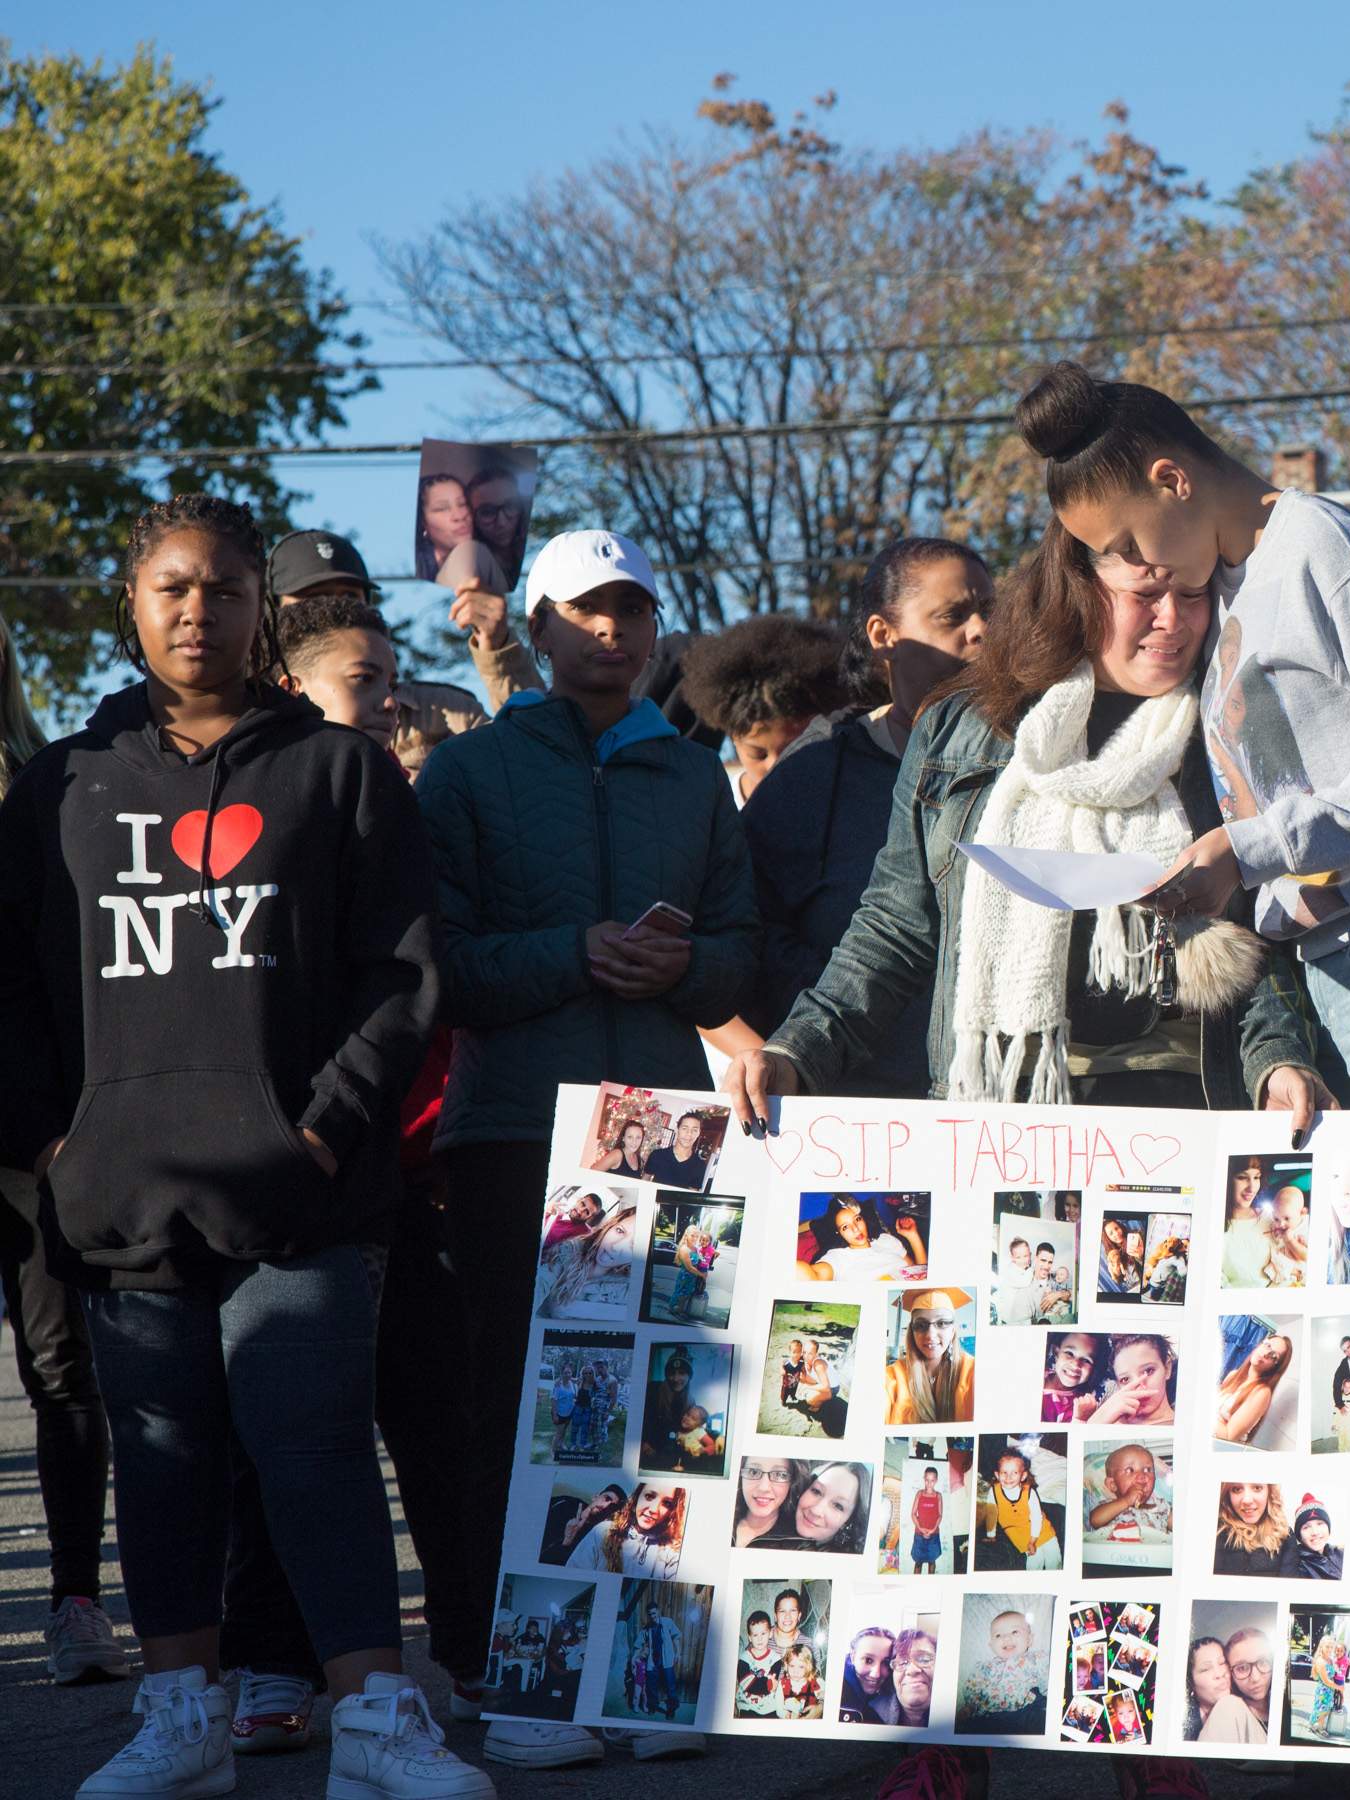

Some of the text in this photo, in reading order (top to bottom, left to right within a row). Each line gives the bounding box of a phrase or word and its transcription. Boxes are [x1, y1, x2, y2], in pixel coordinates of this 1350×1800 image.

[116, 813, 162, 884] I
[98, 883, 279, 979] NY
[808, 1115, 1126, 1191] S.I.P TABITHA
